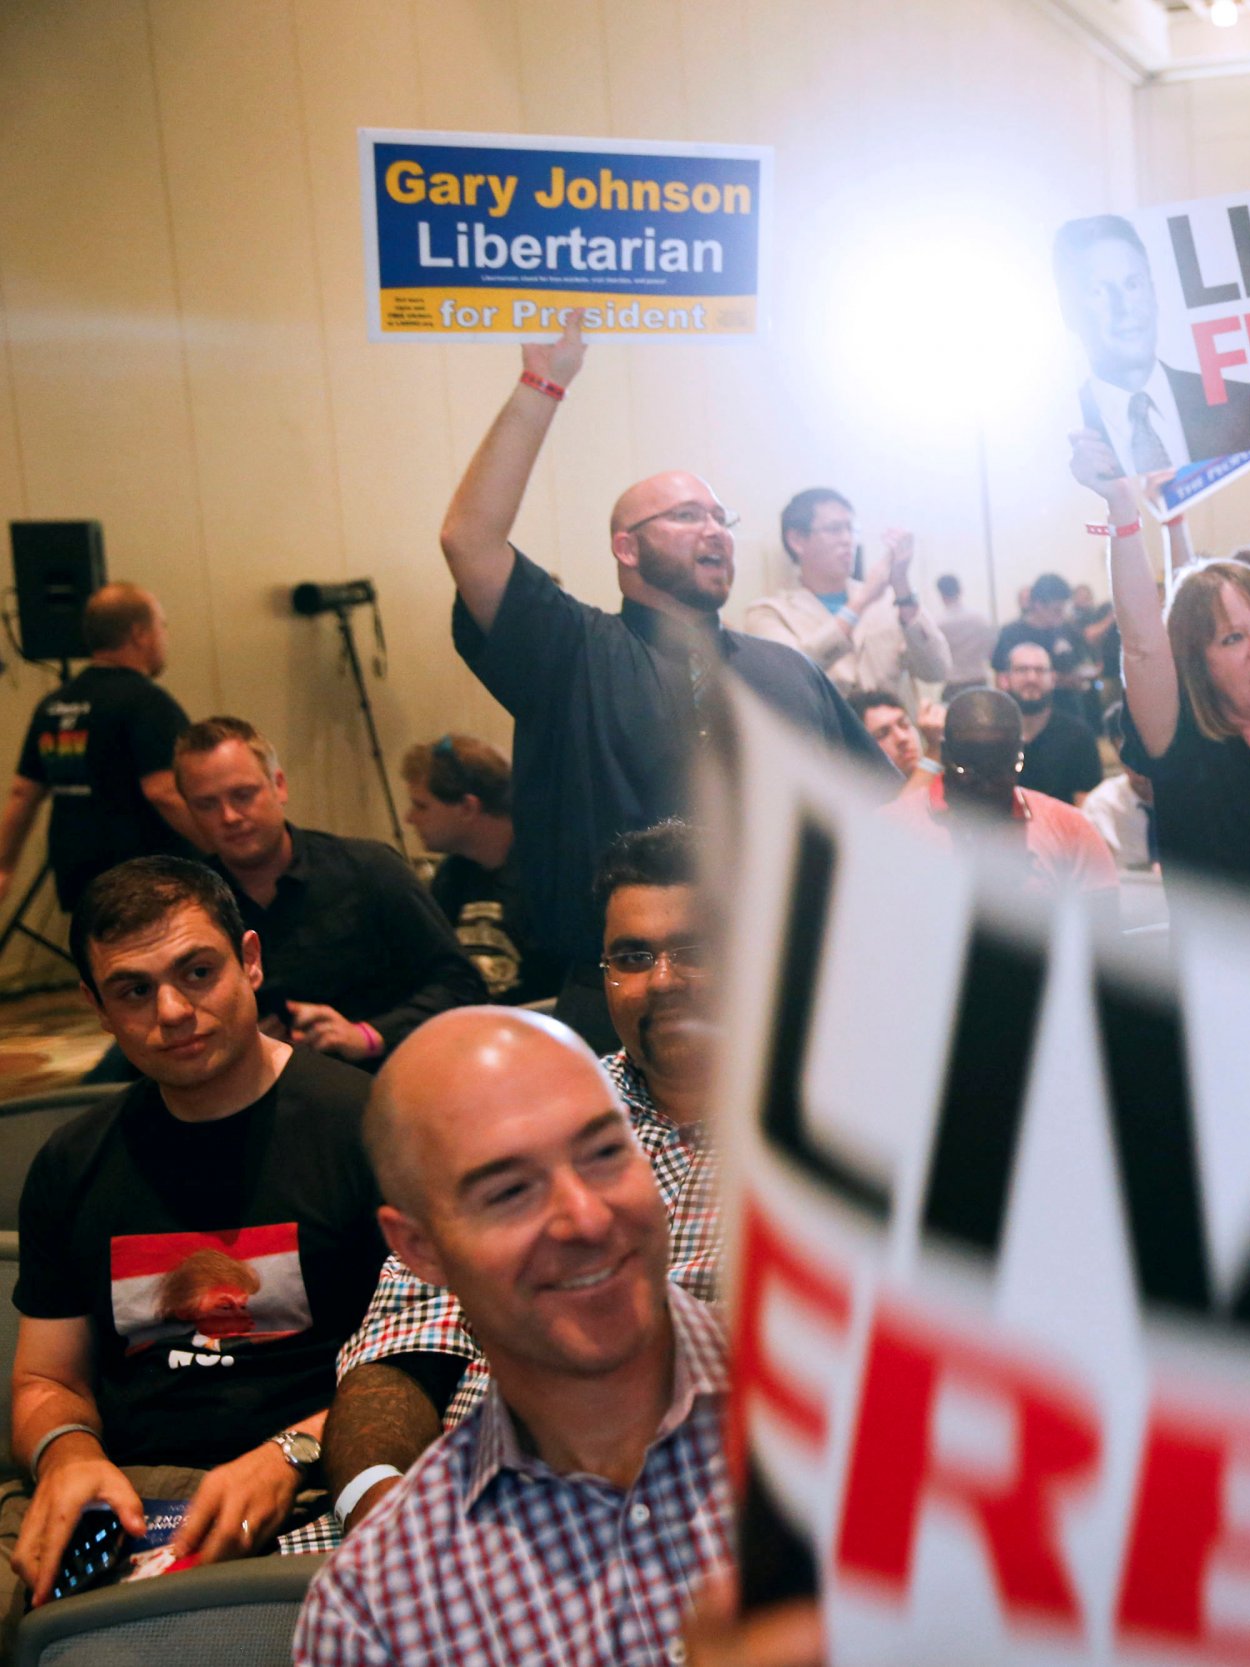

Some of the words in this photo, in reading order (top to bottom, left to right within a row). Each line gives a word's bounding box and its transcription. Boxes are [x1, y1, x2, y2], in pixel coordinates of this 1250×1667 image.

[385, 160, 518, 217] Gary
[534, 166, 751, 214] Johnson
[418, 221, 724, 273] Libertarian
[440, 300, 498, 329] for
[512, 301, 706, 331] President
